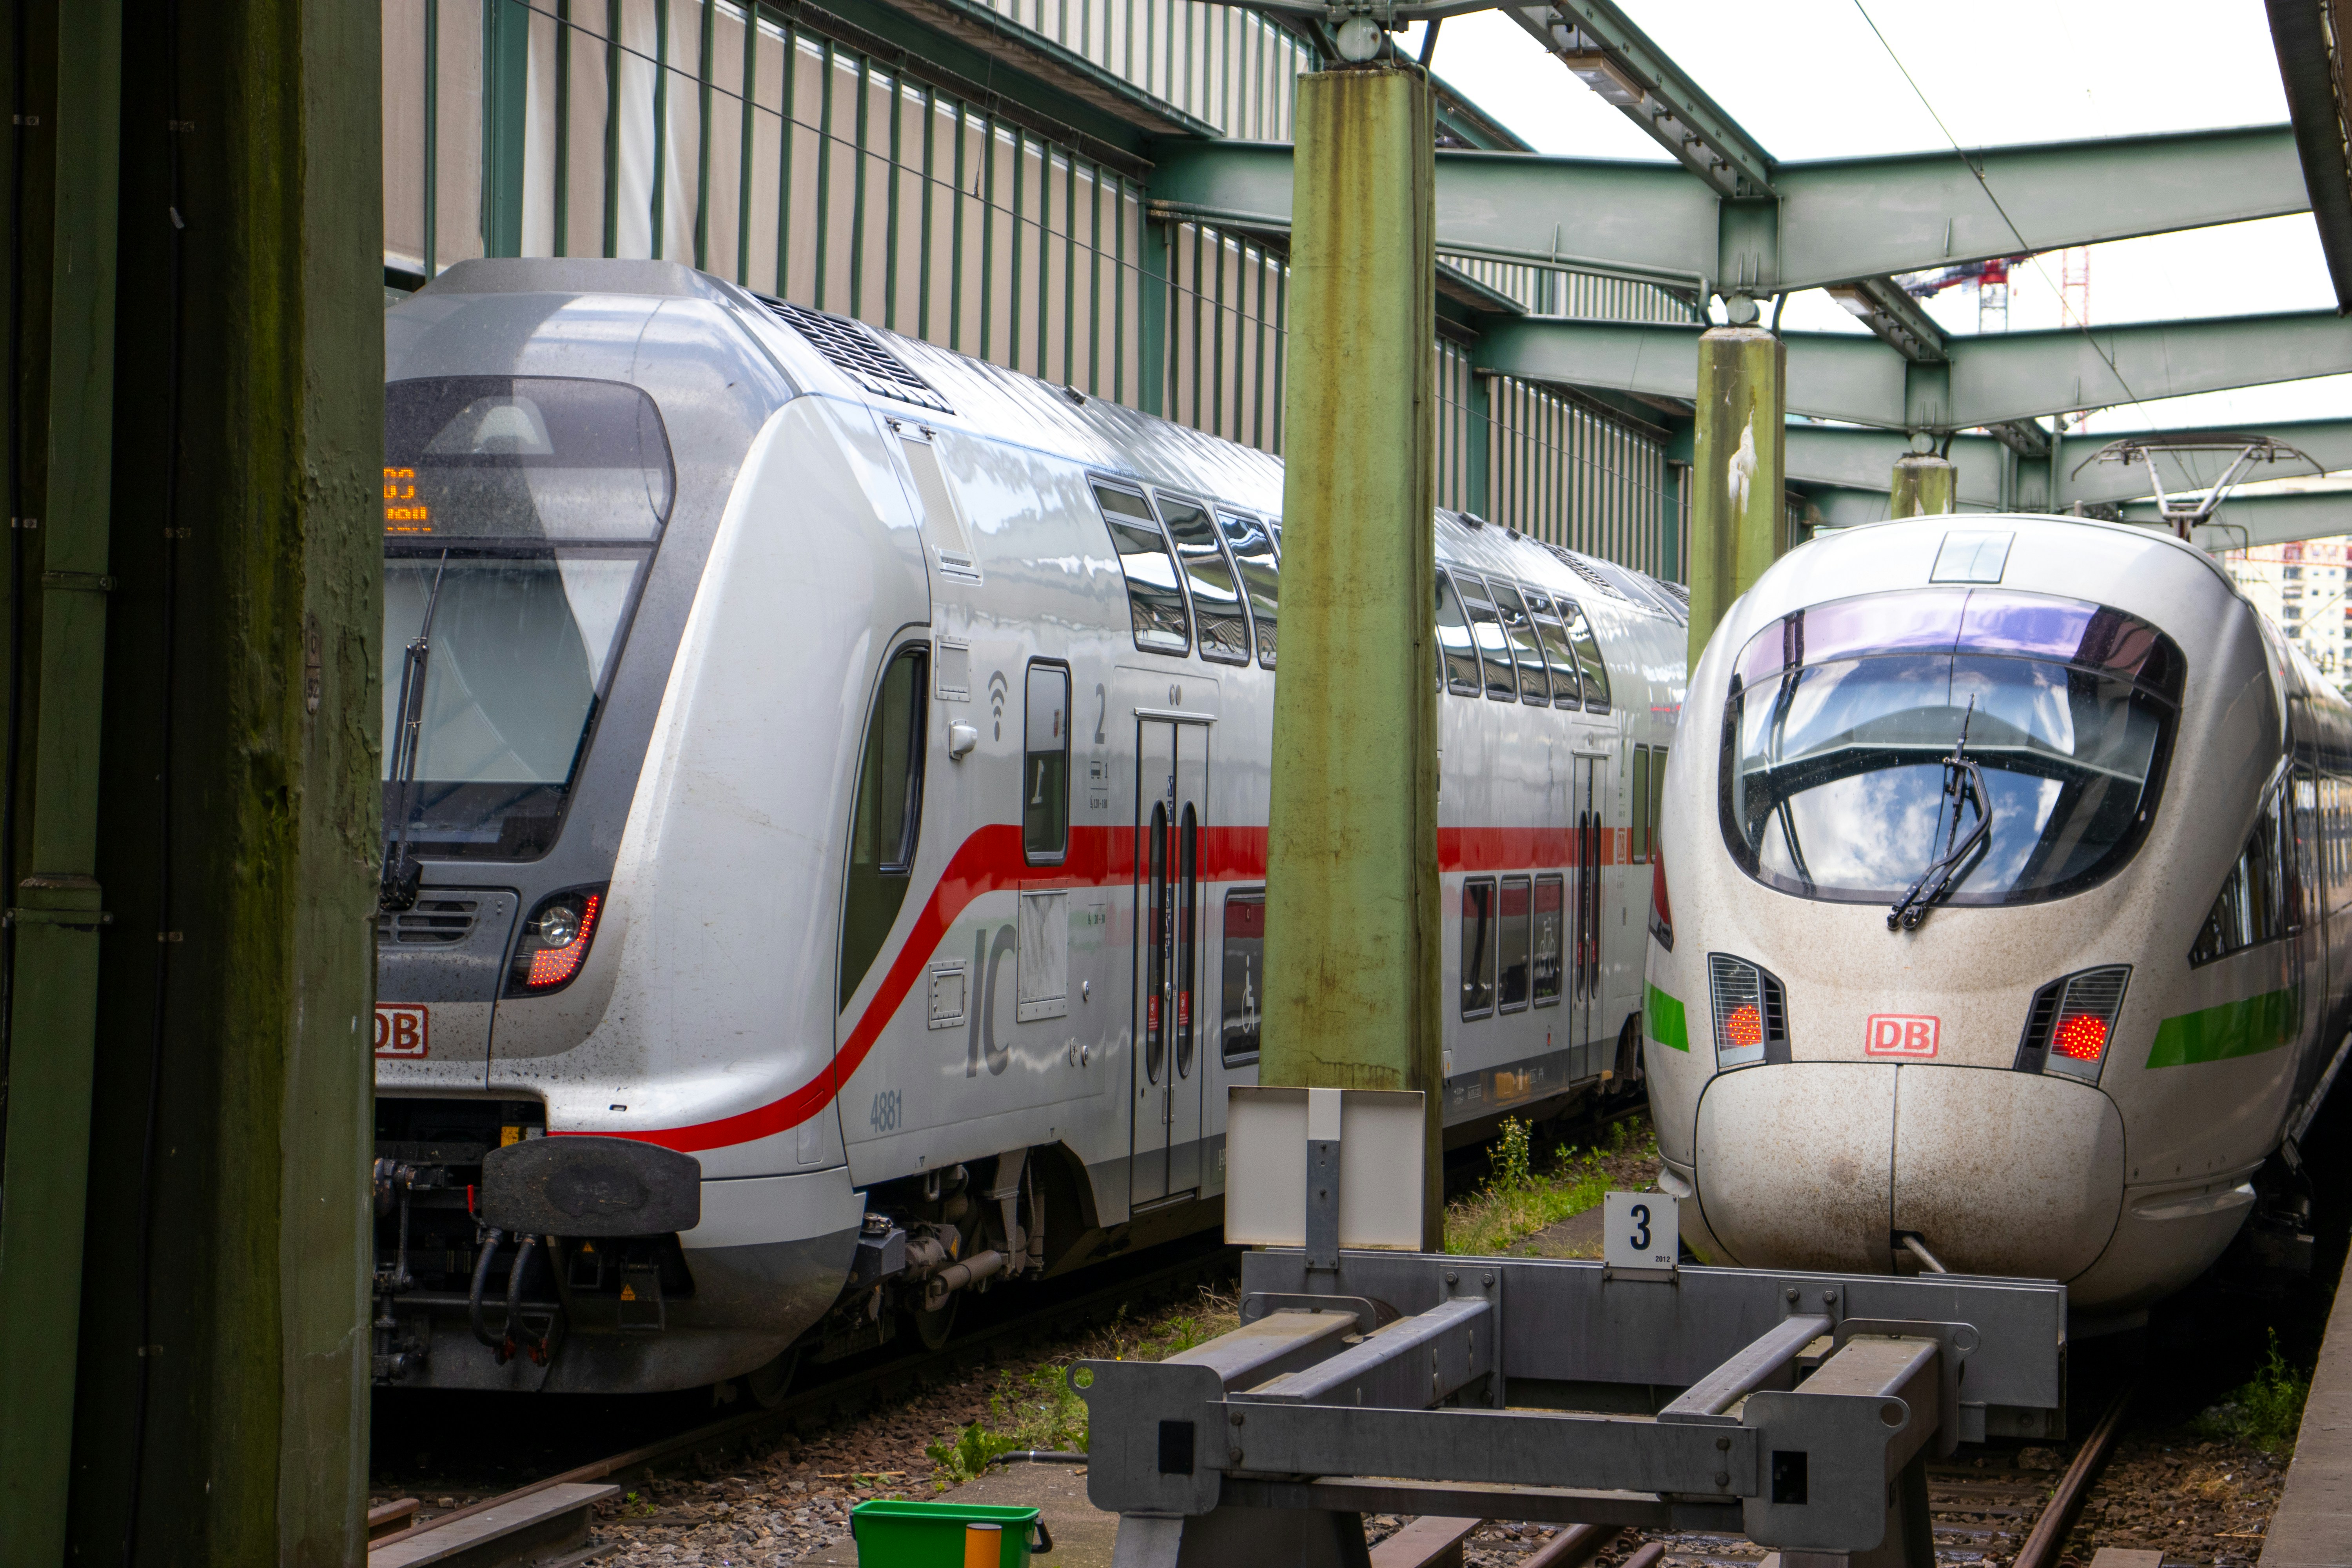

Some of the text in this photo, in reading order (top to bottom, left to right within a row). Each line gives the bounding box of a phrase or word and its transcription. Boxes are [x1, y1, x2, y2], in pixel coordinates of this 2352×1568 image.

[1094, 682, 1105, 744] 2
[966, 924, 1016, 1078] IC
[1875, 1020, 1931, 1051] DB
[870, 1089, 902, 1133] 4881
[1630, 1204, 1651, 1251] 3
